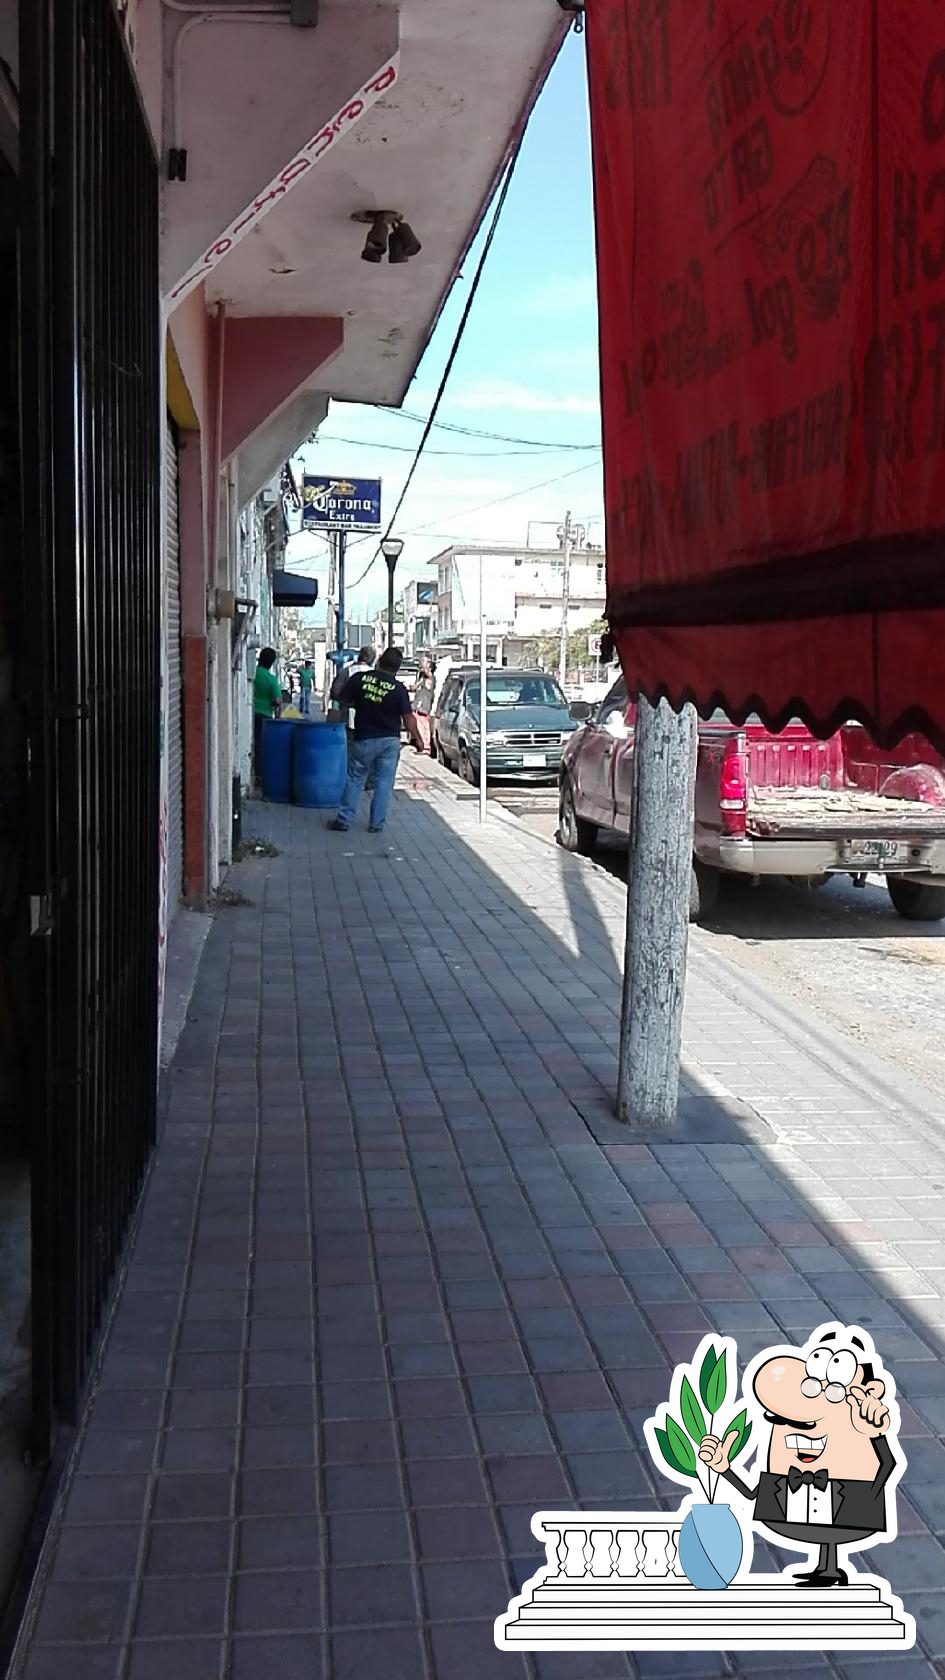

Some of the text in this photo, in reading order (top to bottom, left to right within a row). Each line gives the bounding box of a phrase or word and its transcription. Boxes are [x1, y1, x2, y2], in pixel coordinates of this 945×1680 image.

[312, 492, 372, 514] Corona
[329, 510, 355, 521] Extra
[380, 680, 396, 691] YOU
